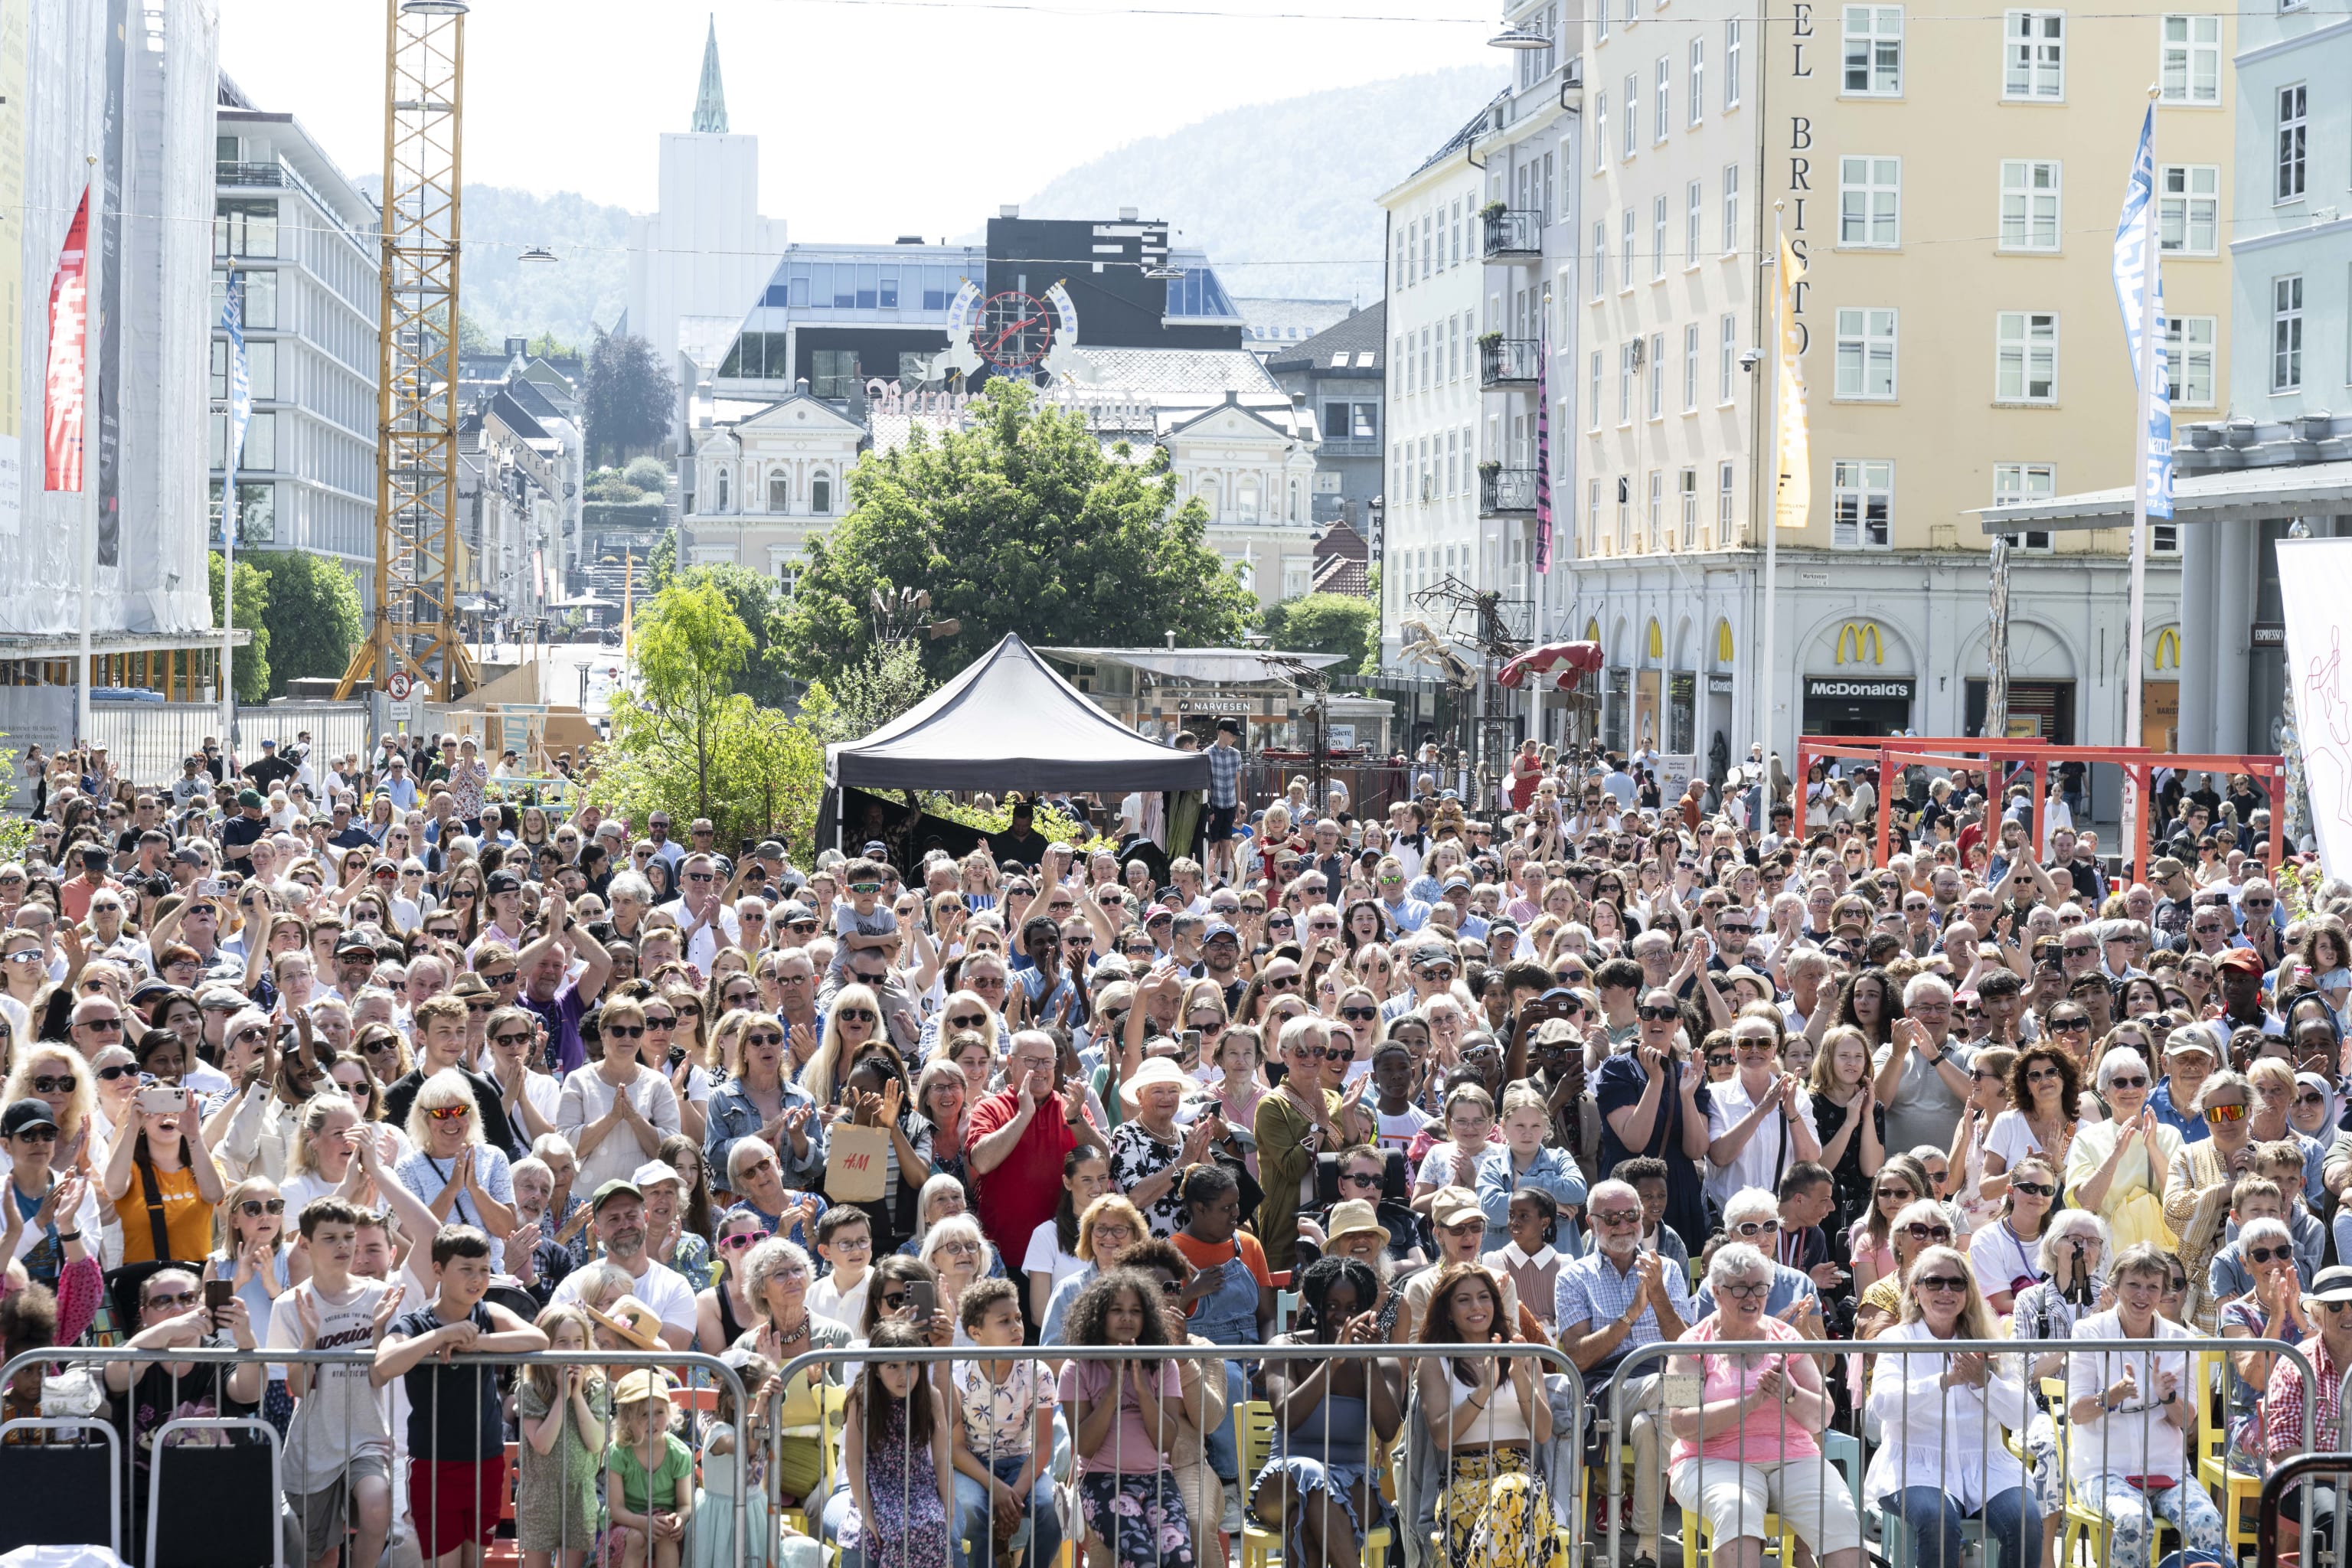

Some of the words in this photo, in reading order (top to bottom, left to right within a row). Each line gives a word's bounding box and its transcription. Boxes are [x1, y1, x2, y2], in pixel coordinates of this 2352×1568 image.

[1789, 117, 1812, 397] BRISTO
[950, 293, 969, 332] ANNO
[1057, 295, 1075, 334] 1868
[866, 378, 988, 426] Bergen
[503, 435, 550, 476] HOTEL
[2255, 629, 2284, 641] ESPRESSO
[1710, 679, 1733, 692] McDonald's
[1811, 683, 1908, 696] McDonald's
[1194, 702, 1251, 711] NARVESEN
[843, 1152, 871, 1172] H&M
